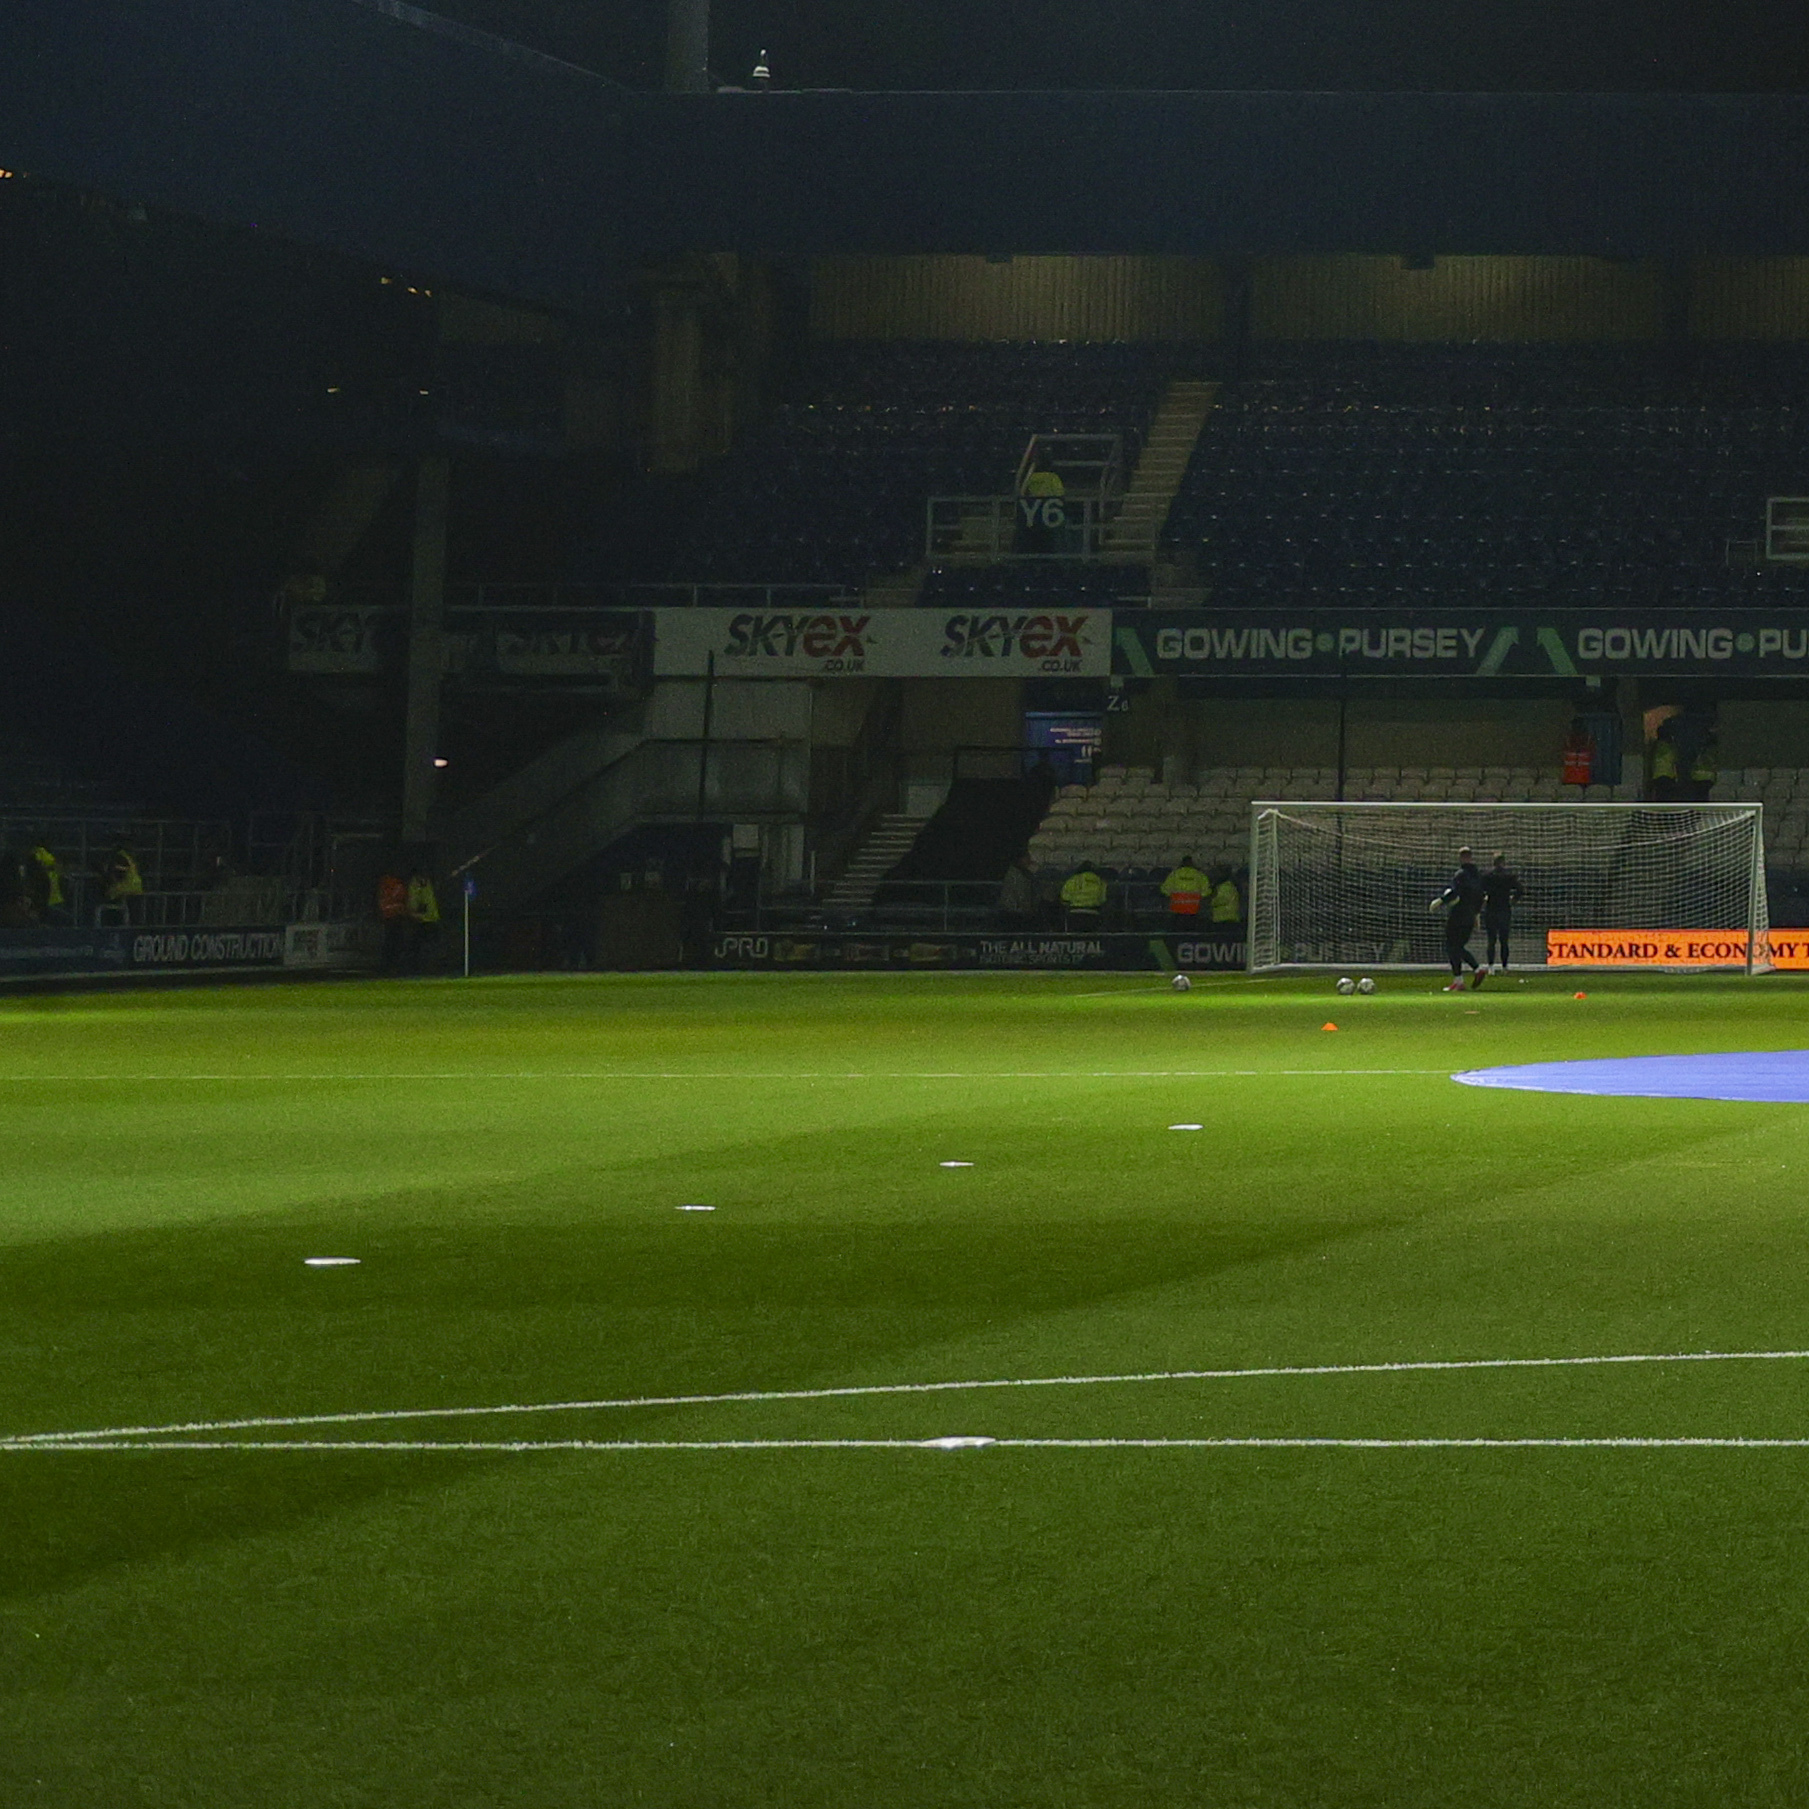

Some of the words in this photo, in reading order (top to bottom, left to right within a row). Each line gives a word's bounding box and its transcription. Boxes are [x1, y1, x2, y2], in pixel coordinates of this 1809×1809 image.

[1020, 498, 1065, 528] Y6
[1157, 628, 1312, 659] GOWING
[1339, 628, 1485, 659] PURSEY
[1577, 628, 1733, 659] GOWING
[133, 934, 189, 962] GROUND
[1665, 943, 1681, 959] &
